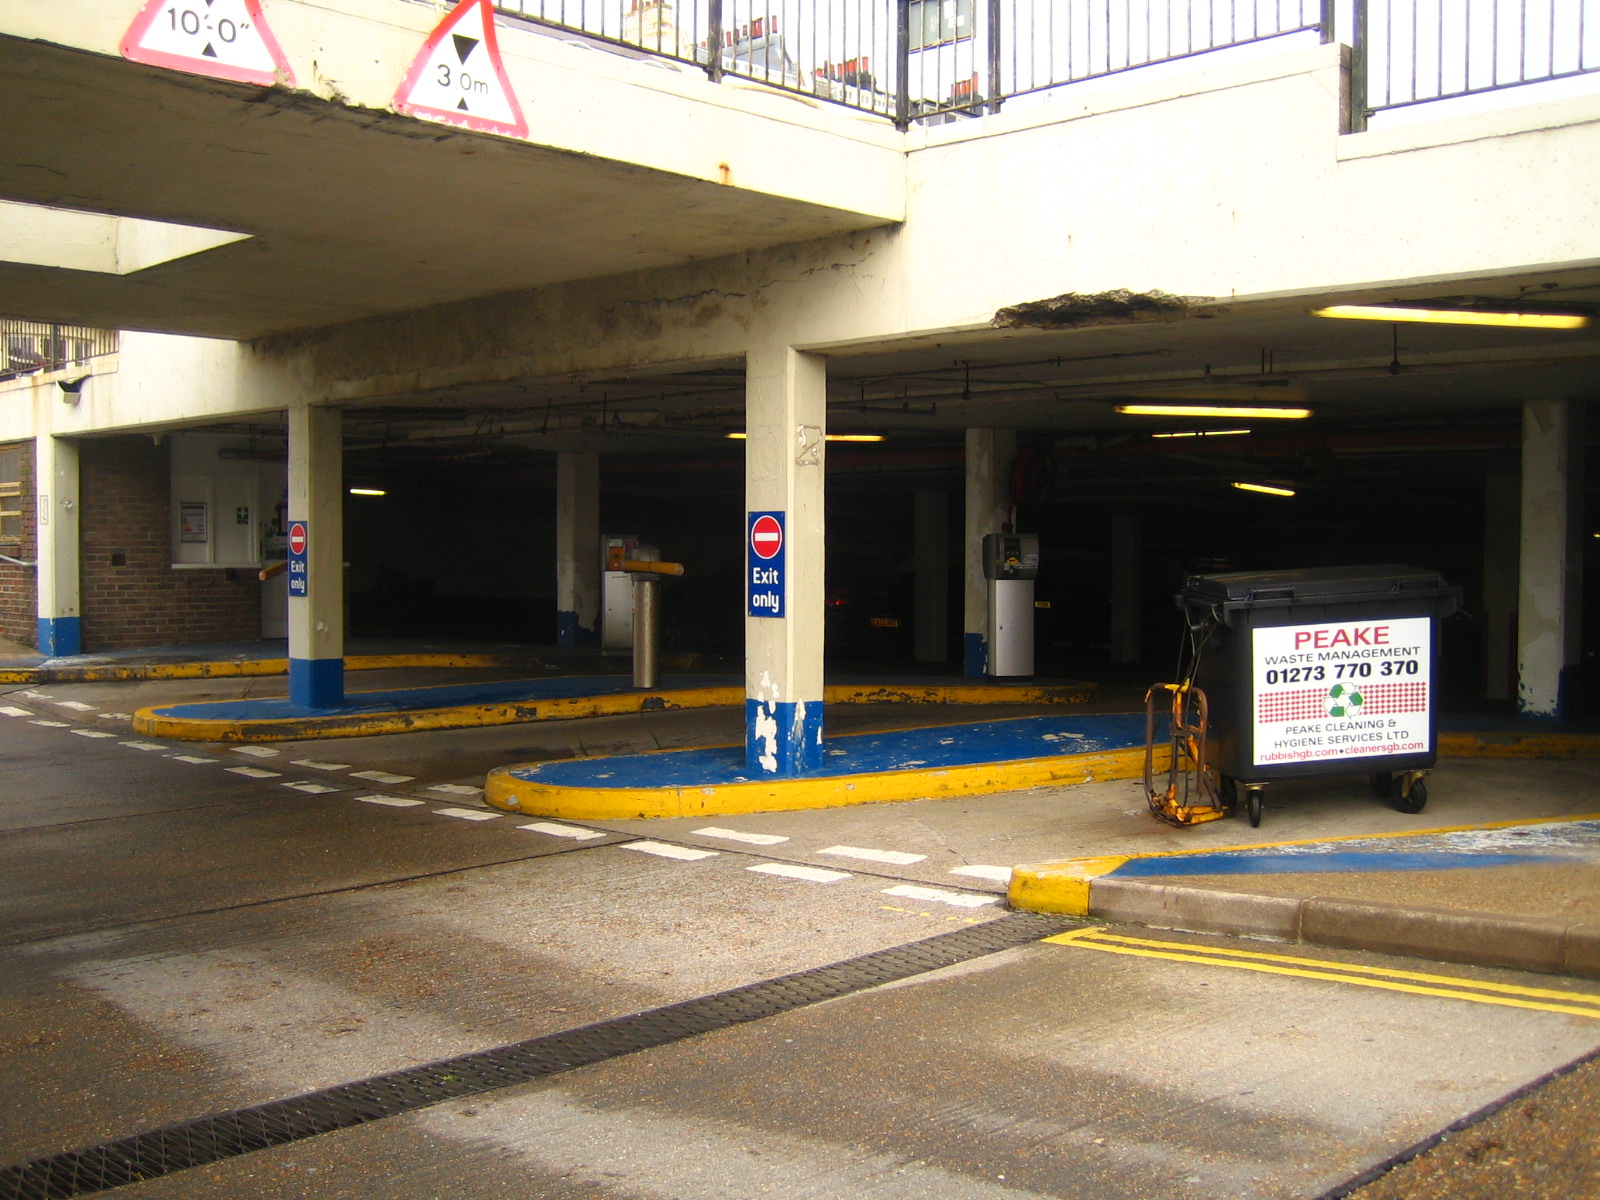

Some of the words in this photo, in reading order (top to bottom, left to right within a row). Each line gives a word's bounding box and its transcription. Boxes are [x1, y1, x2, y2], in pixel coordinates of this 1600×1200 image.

[291, 560, 304, 573] Exit
[753, 567, 779, 585] Exit
[290, 577, 305, 593] only
[752, 590, 780, 613] only
[1295, 626, 1389, 650] PEAKE
[1265, 653, 1314, 665] WASTE
[1318, 646, 1421, 662] MANAGEMENT
[1266, 665, 1325, 685] 01273
[1334, 662, 1372, 679] 770
[1380, 660, 1418, 677] 370
[1285, 723, 1322, 735] PEAKE
[1325, 719, 1384, 732] CLEANING
[1388, 719, 1397, 727] &
[1274, 736, 1324, 749] HYGIENE
[1327, 732, 1383, 745] SERVICES
[1386, 730, 1409, 740] LTD
